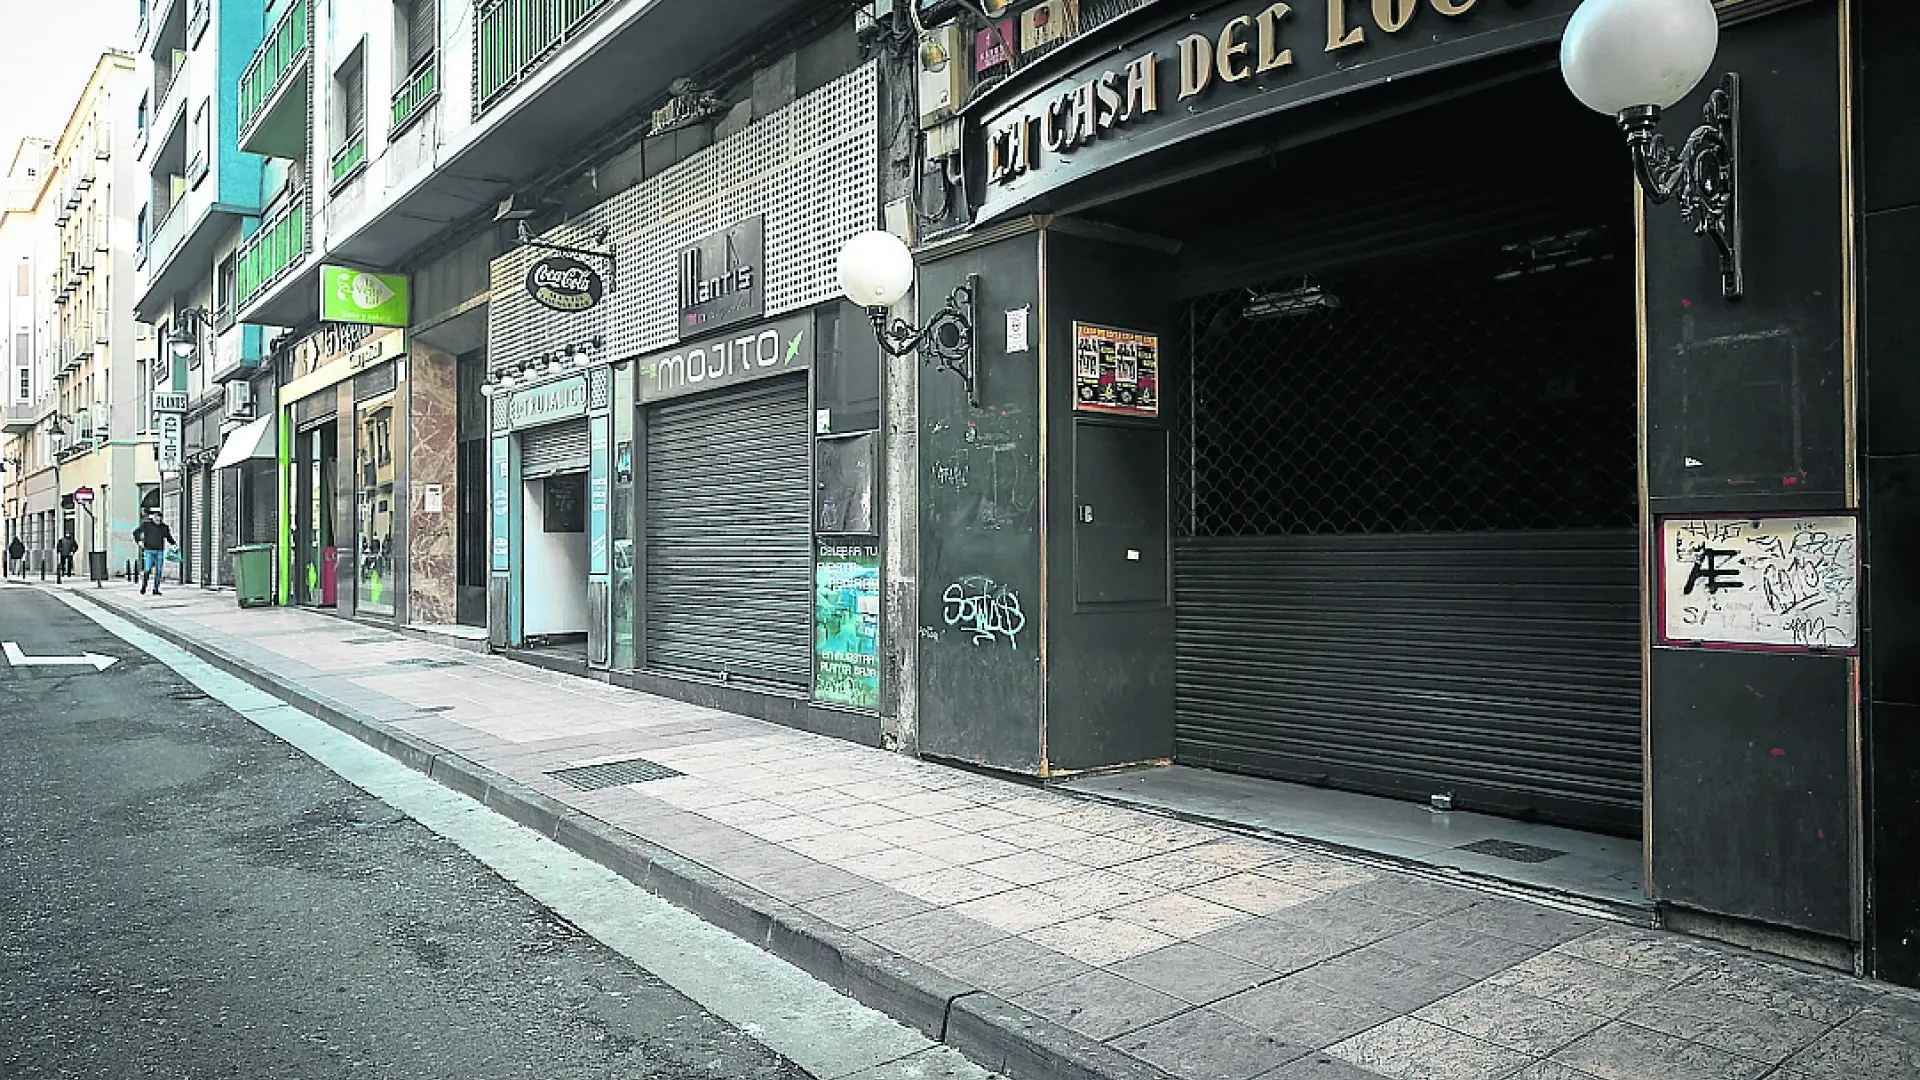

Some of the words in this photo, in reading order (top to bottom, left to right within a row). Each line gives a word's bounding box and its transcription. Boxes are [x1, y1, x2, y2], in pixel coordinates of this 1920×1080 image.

[986, 115, 1029, 181] LA
[1041, 51, 1158, 153] CASA
[1176, 2, 1293, 101] DEL
[657, 329, 780, 392] MOJITO
[864, 546, 878, 557] TU
